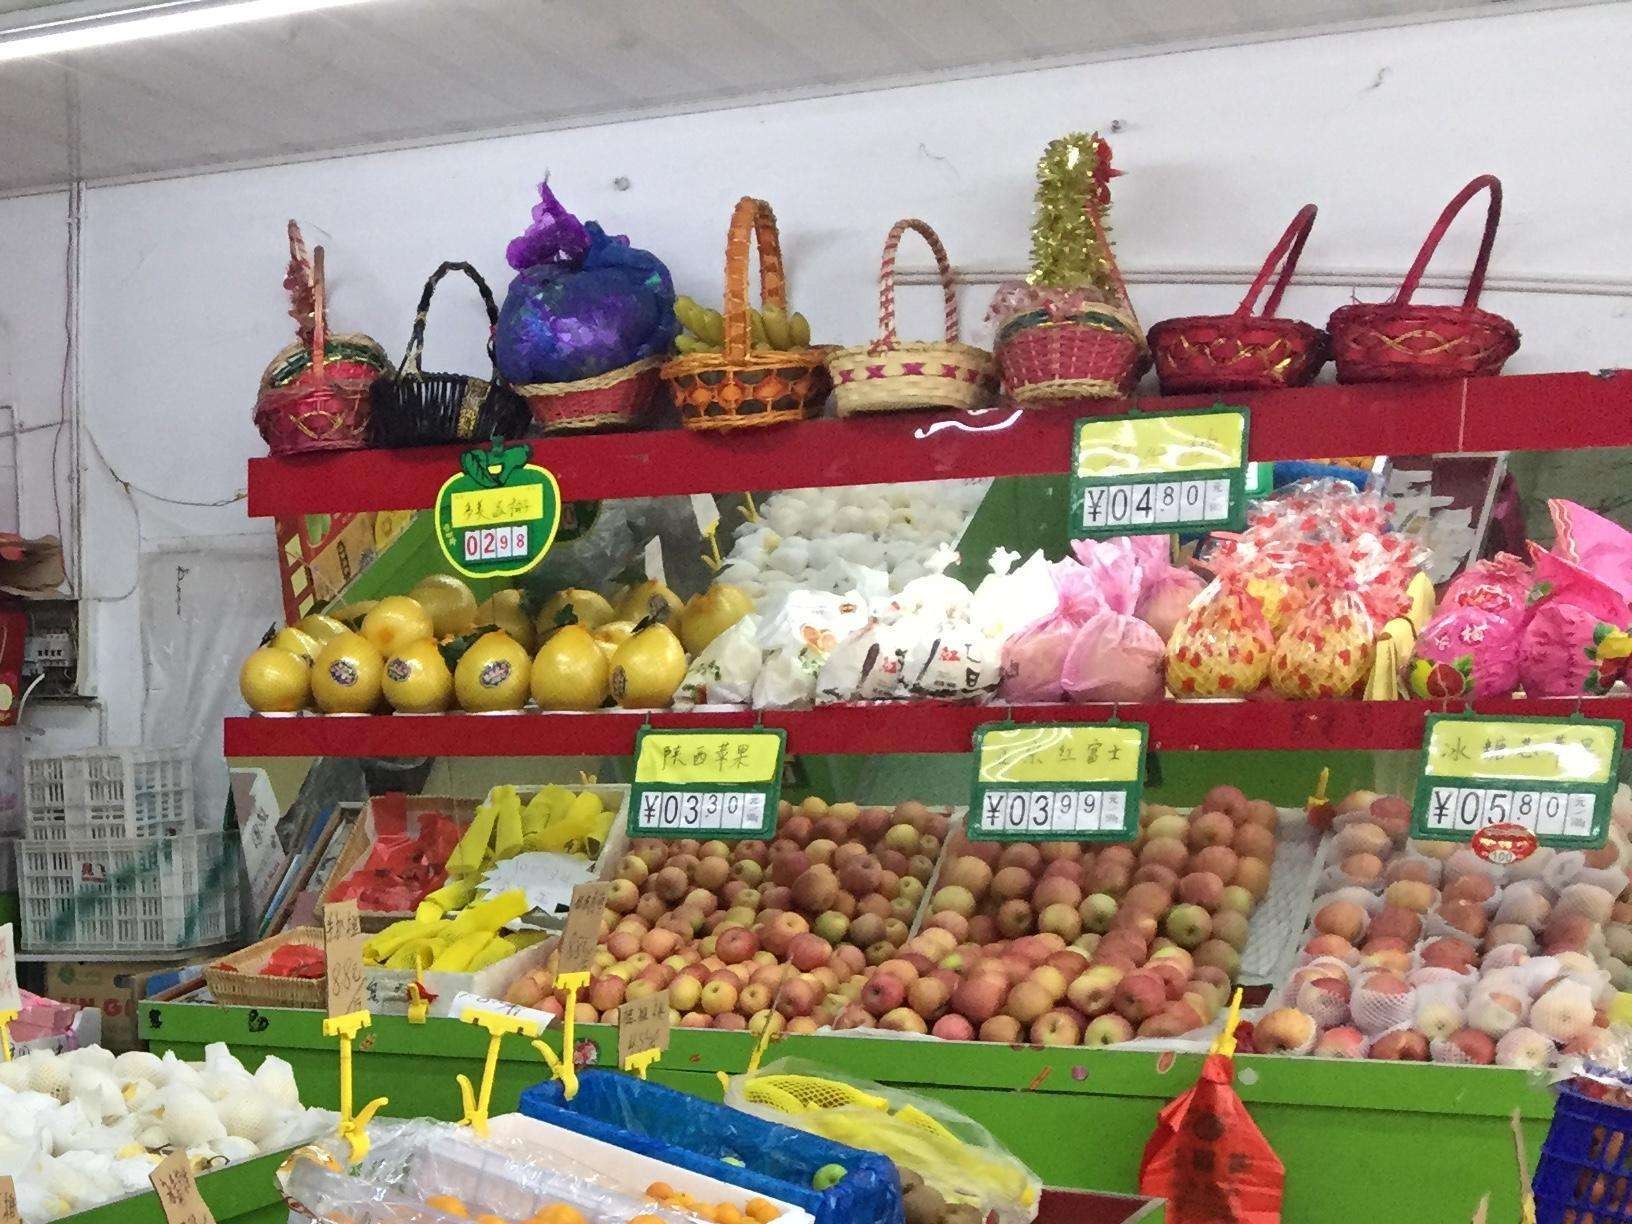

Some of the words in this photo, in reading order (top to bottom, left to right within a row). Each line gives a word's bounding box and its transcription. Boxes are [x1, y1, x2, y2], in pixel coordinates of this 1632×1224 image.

[466, 532, 525, 556] 0298
[661, 742, 751, 772] 陕西苹果
[644, 793, 739, 825] ¥03.30
